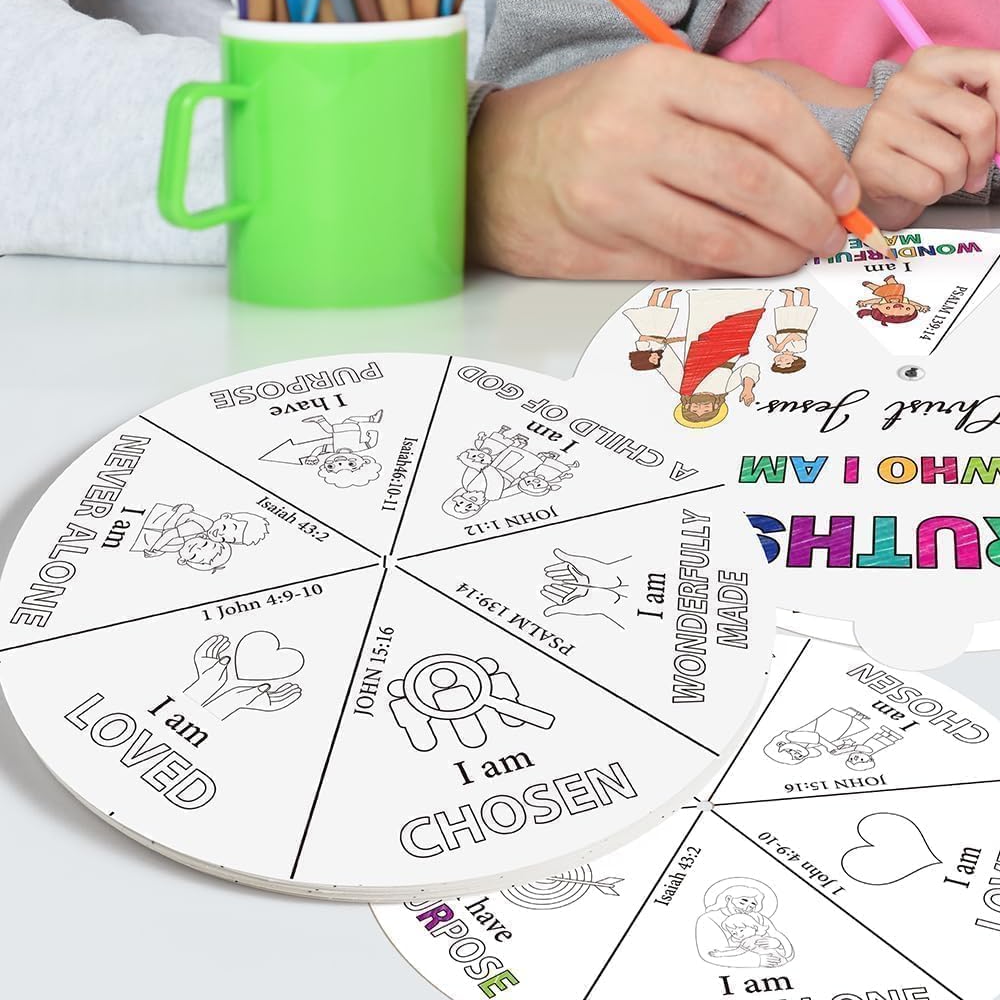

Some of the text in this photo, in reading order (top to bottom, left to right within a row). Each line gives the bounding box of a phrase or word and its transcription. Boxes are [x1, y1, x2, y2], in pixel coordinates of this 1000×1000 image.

[848, 233, 923, 250] MAE
[864, 261, 914, 273] I am
[919, 285, 968, 341] PSALM 139:14
[210, 362, 383, 409] PURPOSE
[269, 393, 348, 416] I have
[457, 365, 699, 481] A CHILD OF GOD
[755, 388, 870, 433] Jesus.
[526, 420, 580, 453] I am
[382, 437, 418, 511] Isaiah46:10-11
[738, 455, 829, 485] AM
[843, 456, 860, 485] I
[10, 434, 151, 628] NEVER ALONE
[101, 506, 146, 549] I am
[256, 496, 330, 543] Isaiah 43:2
[464, 505, 559, 536] JOHN 1:12
[201, 583, 324, 621] 1 John 4:9-10
[455, 582, 576, 657] PSALM 139:14
[637, 572, 666, 620] I am
[672, 509, 711, 704] WONDERFULLY
[717, 570, 748, 649] MADE
[353, 626, 394, 717] JOHN 15:16
[146, 695, 209, 748] I am
[846, 662, 990, 744] CHOSEN
[871, 700, 921, 733] I am
[64, 693, 217, 810] LOVED
[453, 751, 536, 786] I am
[784, 774, 888, 794] JOHN 15:16
[400, 762, 638, 858] CHOSEN
[653, 846, 703, 907] Isaiah 43:2
[757, 831, 846, 896] 1 John 4:9-10
[944, 846, 982, 889] I am
[464, 896, 512, 942] have
[403, 899, 520, 999] URPOSE
[718, 975, 735, 996] I
[743, 974, 795, 994] am
